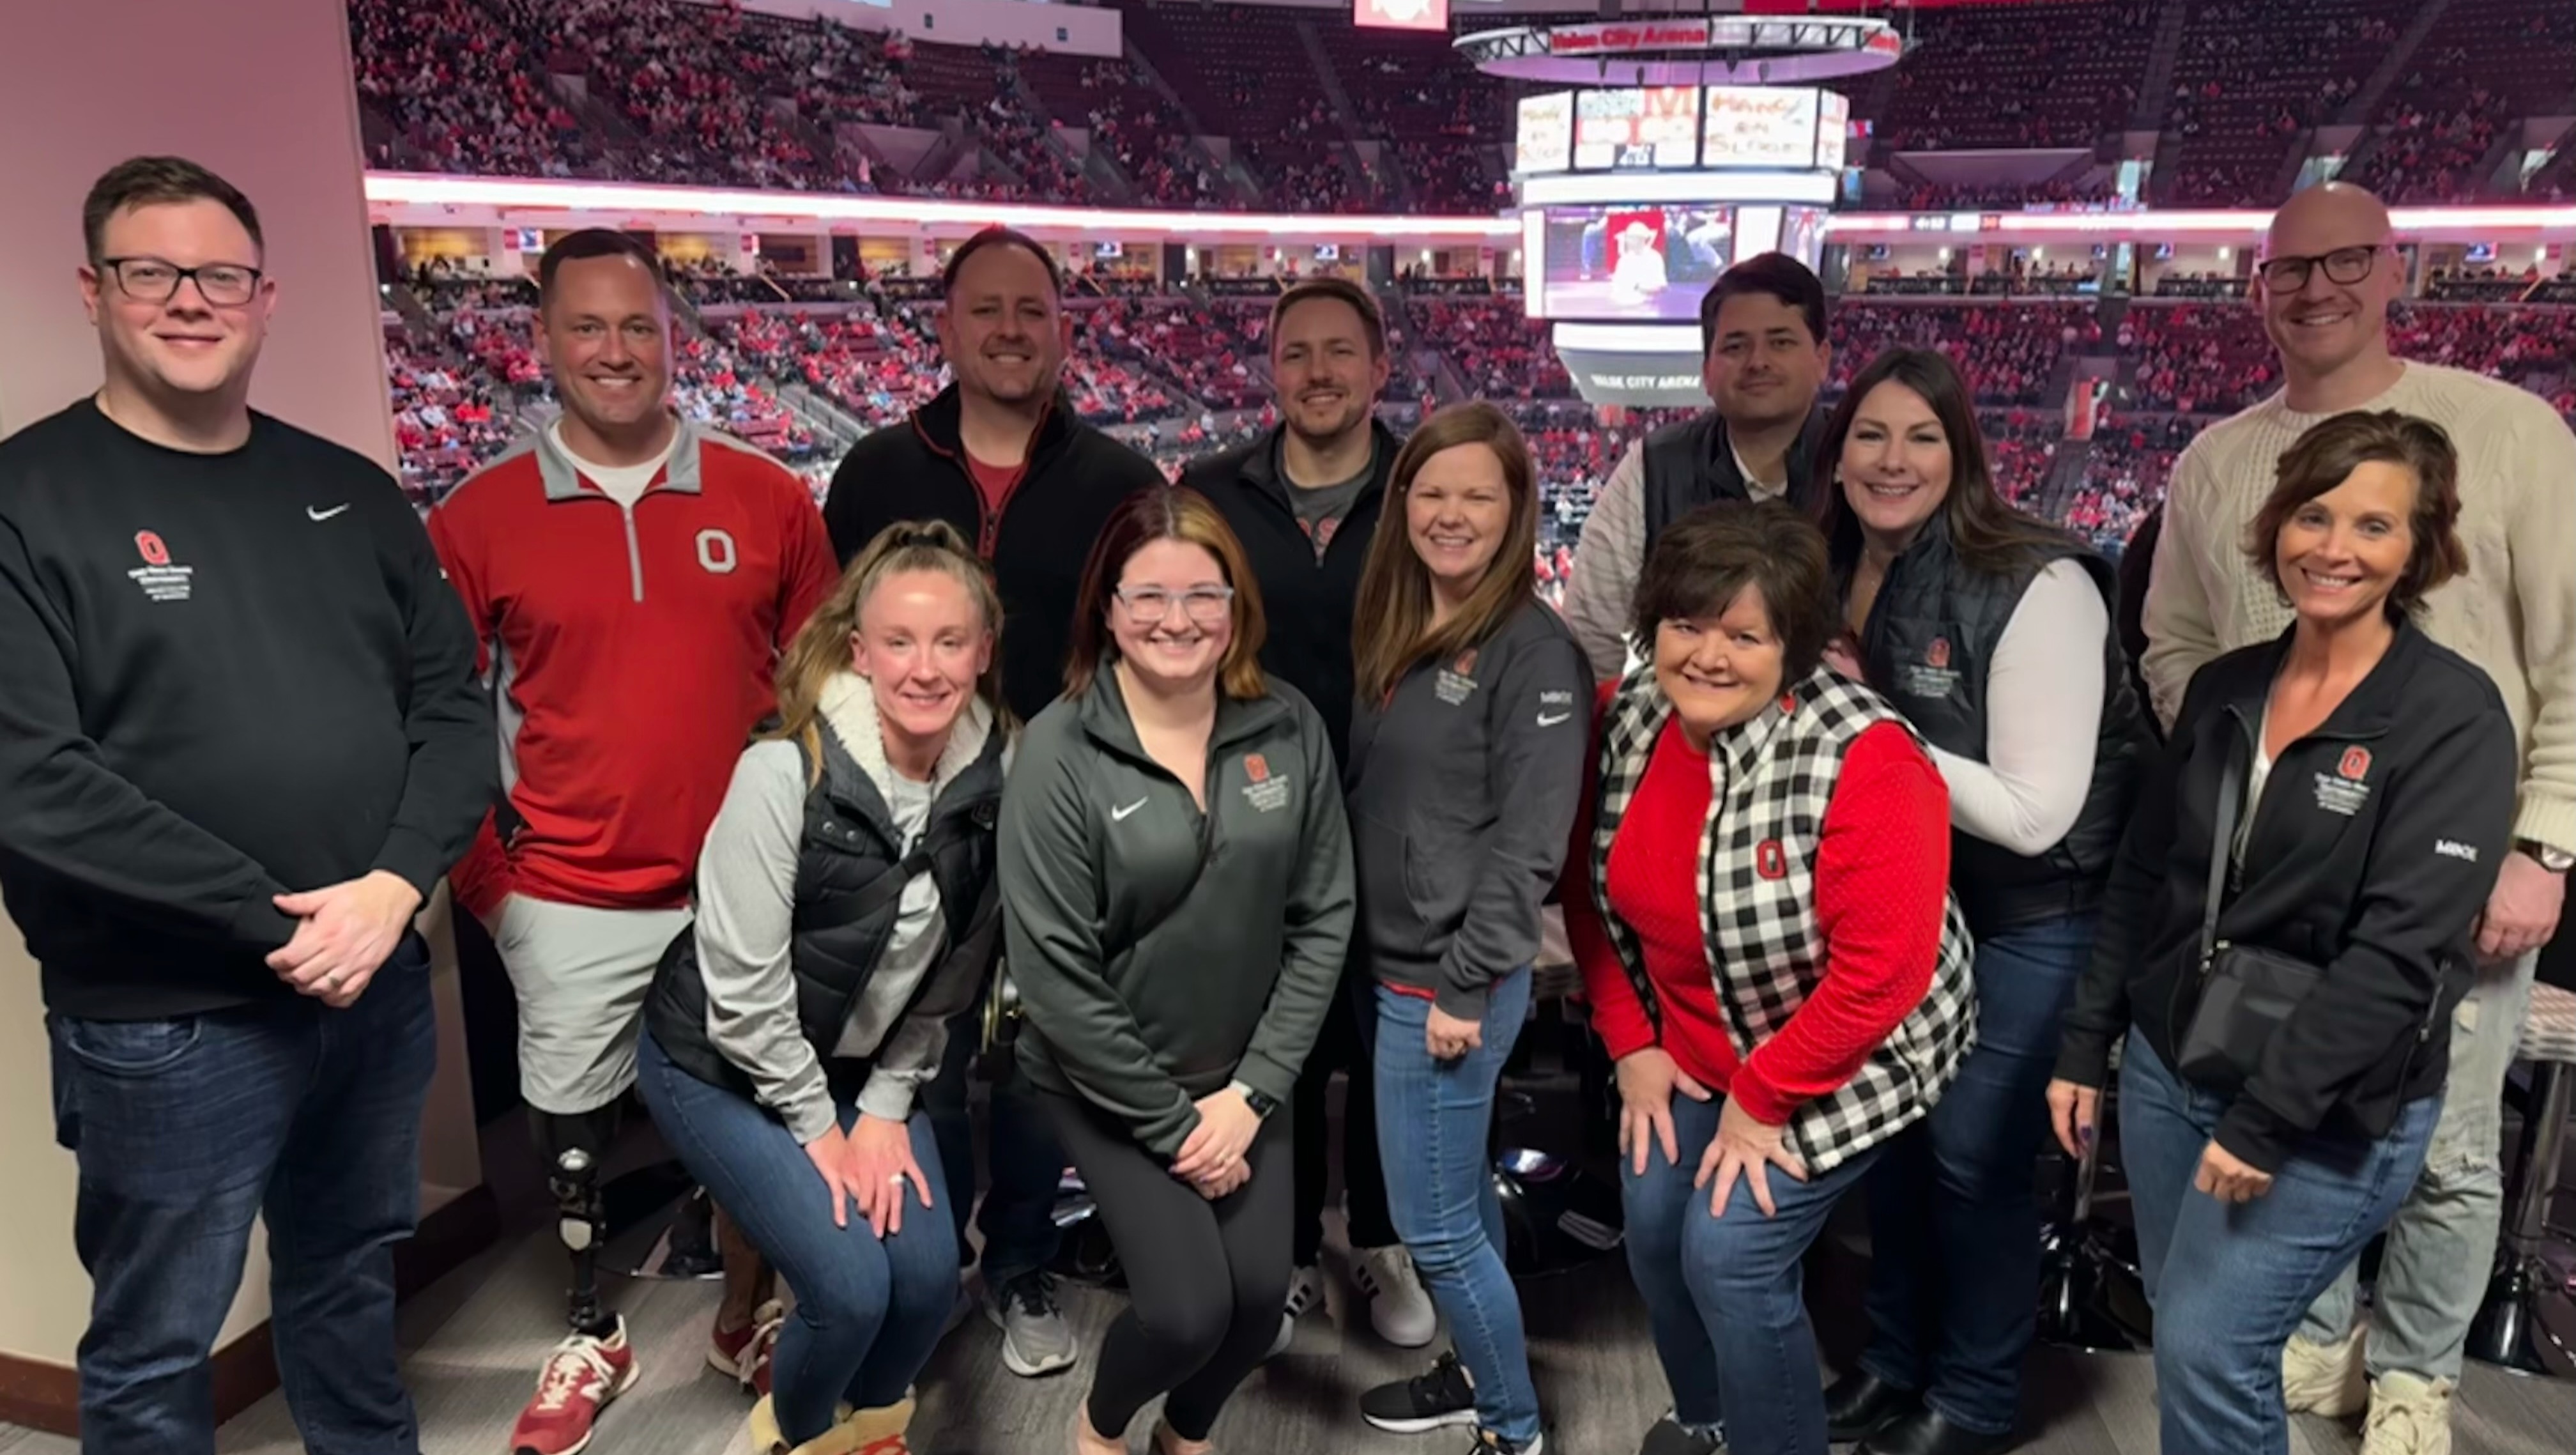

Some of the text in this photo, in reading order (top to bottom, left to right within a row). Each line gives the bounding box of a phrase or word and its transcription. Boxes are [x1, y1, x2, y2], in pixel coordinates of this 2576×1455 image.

[1626, 375, 1656, 389] CITY
[694, 528, 737, 574] O
[2338, 744, 2372, 781] O
[1756, 838, 1786, 881] O
